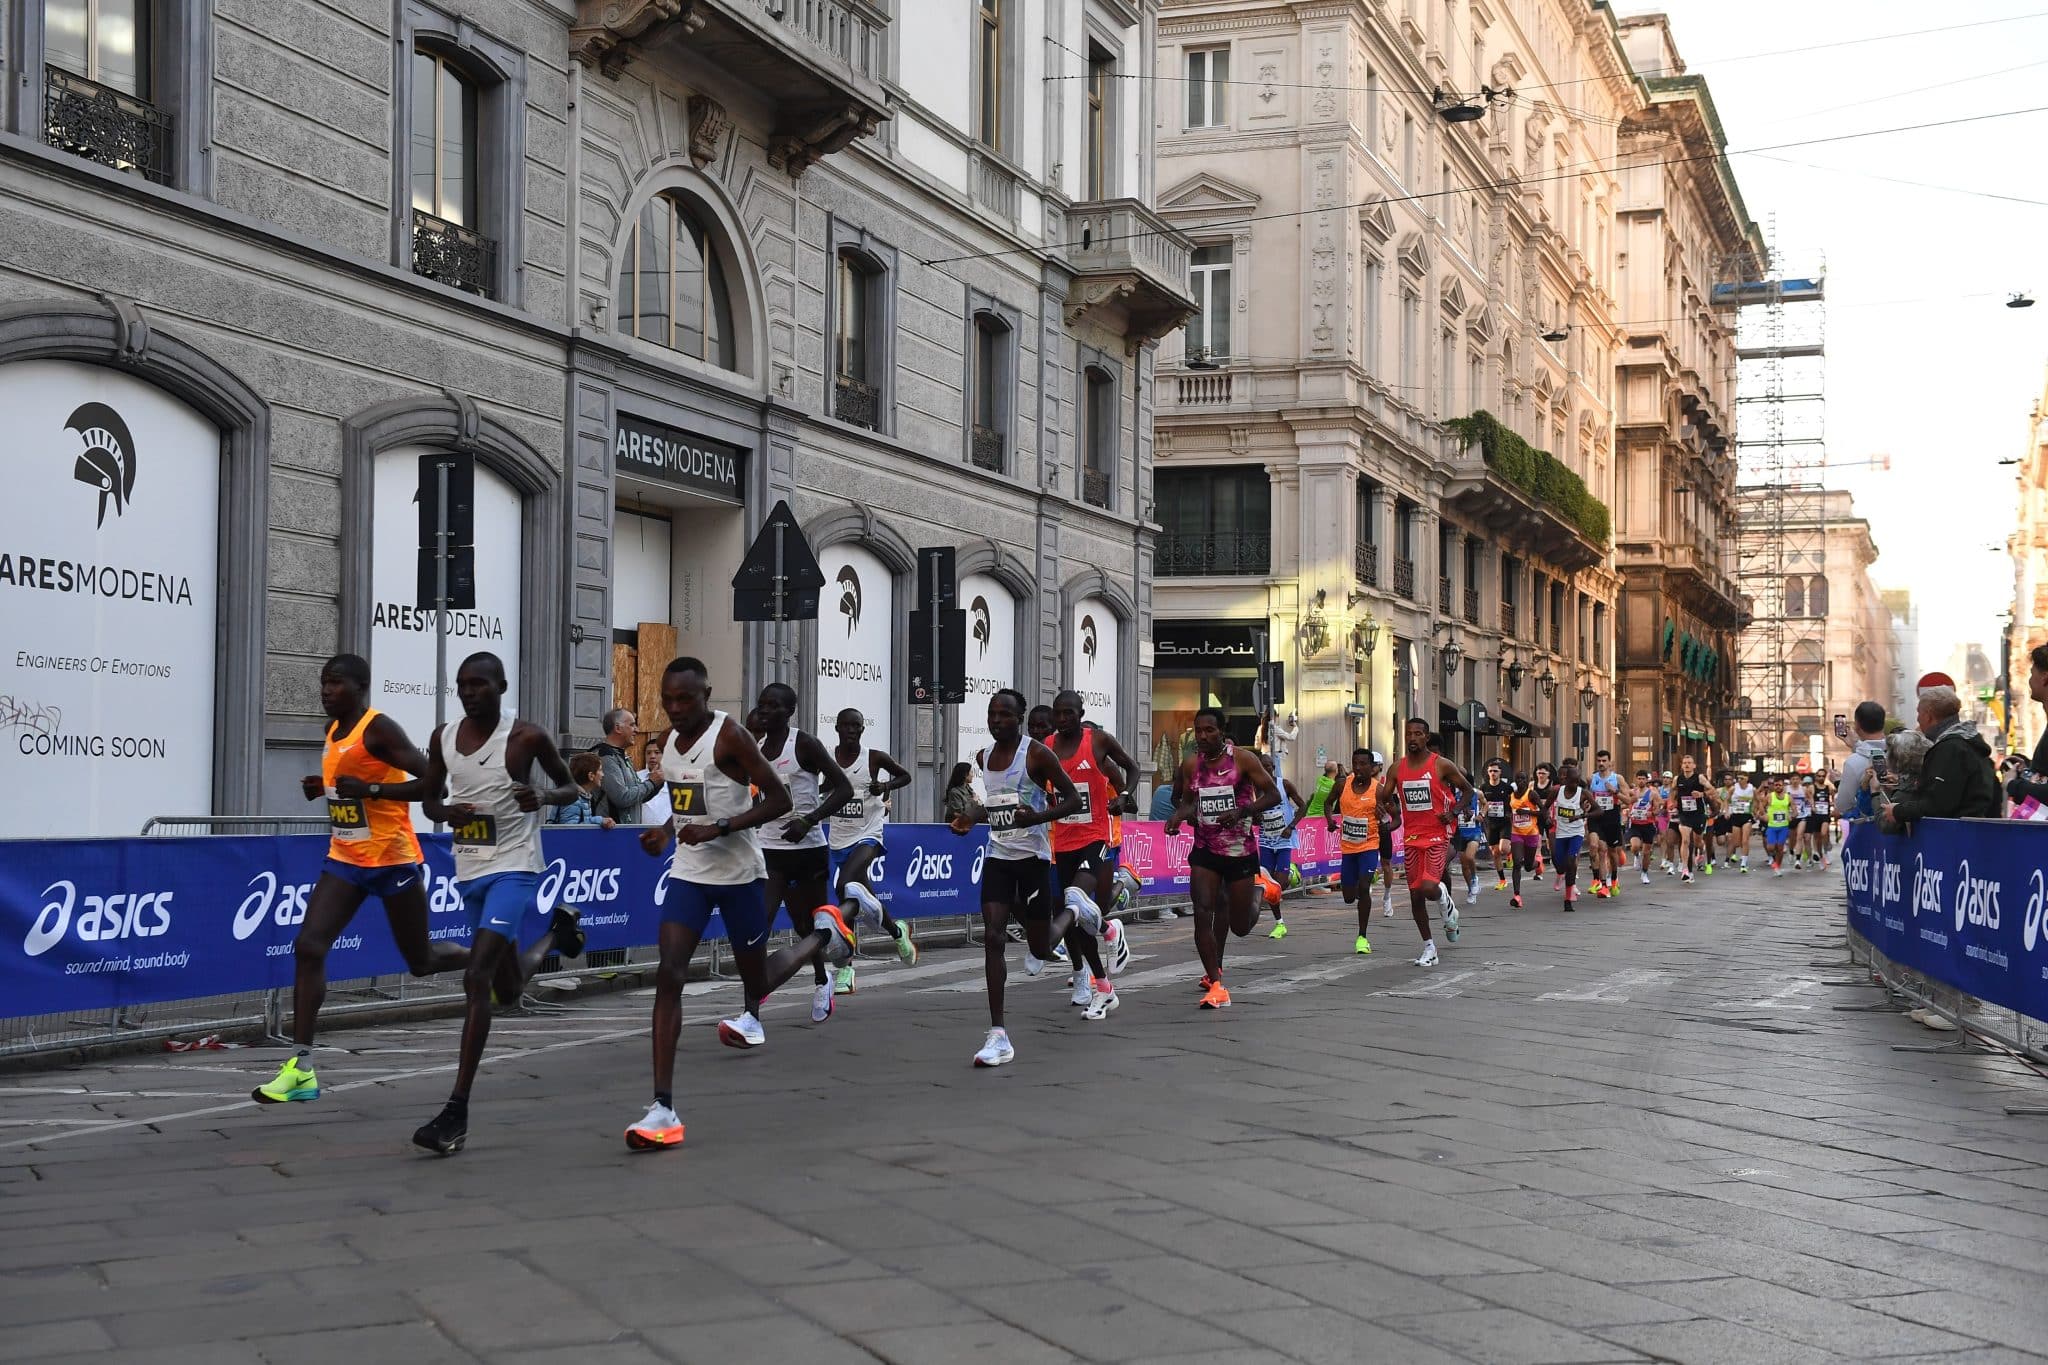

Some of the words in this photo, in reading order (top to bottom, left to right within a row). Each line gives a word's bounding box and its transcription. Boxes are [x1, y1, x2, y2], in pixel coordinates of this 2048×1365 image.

[616, 428, 736, 486] ARESMODENA
[0, 553, 193, 606] ARESMODENA
[16, 651, 87, 672] ENGINEERS
[111, 658, 171, 678] EMOTIONS
[817, 658, 882, 682] RESMODENA
[383, 679, 421, 695] BESPOKE
[19, 733, 104, 757] COMING
[111, 736, 165, 759] SOON
[672, 788, 693, 811] 27
[1202, 798, 1234, 813] BEKELE
[1405, 790, 1429, 801] YEGON
[922, 854, 953, 880] asics
[563, 867, 621, 904] asics
[1968, 877, 2000, 930] asics
[76, 891, 174, 941] asics
[595, 912, 613, 925] sound
[613, 911, 630, 926] body
[341, 934, 363, 951] body
[428, 925, 448, 940] ound
[266, 941, 294, 957] sound
[65, 957, 104, 975] sound
[102, 955, 131, 972] mind,
[134, 952, 164, 970] sound
[164, 950, 190, 969] body
